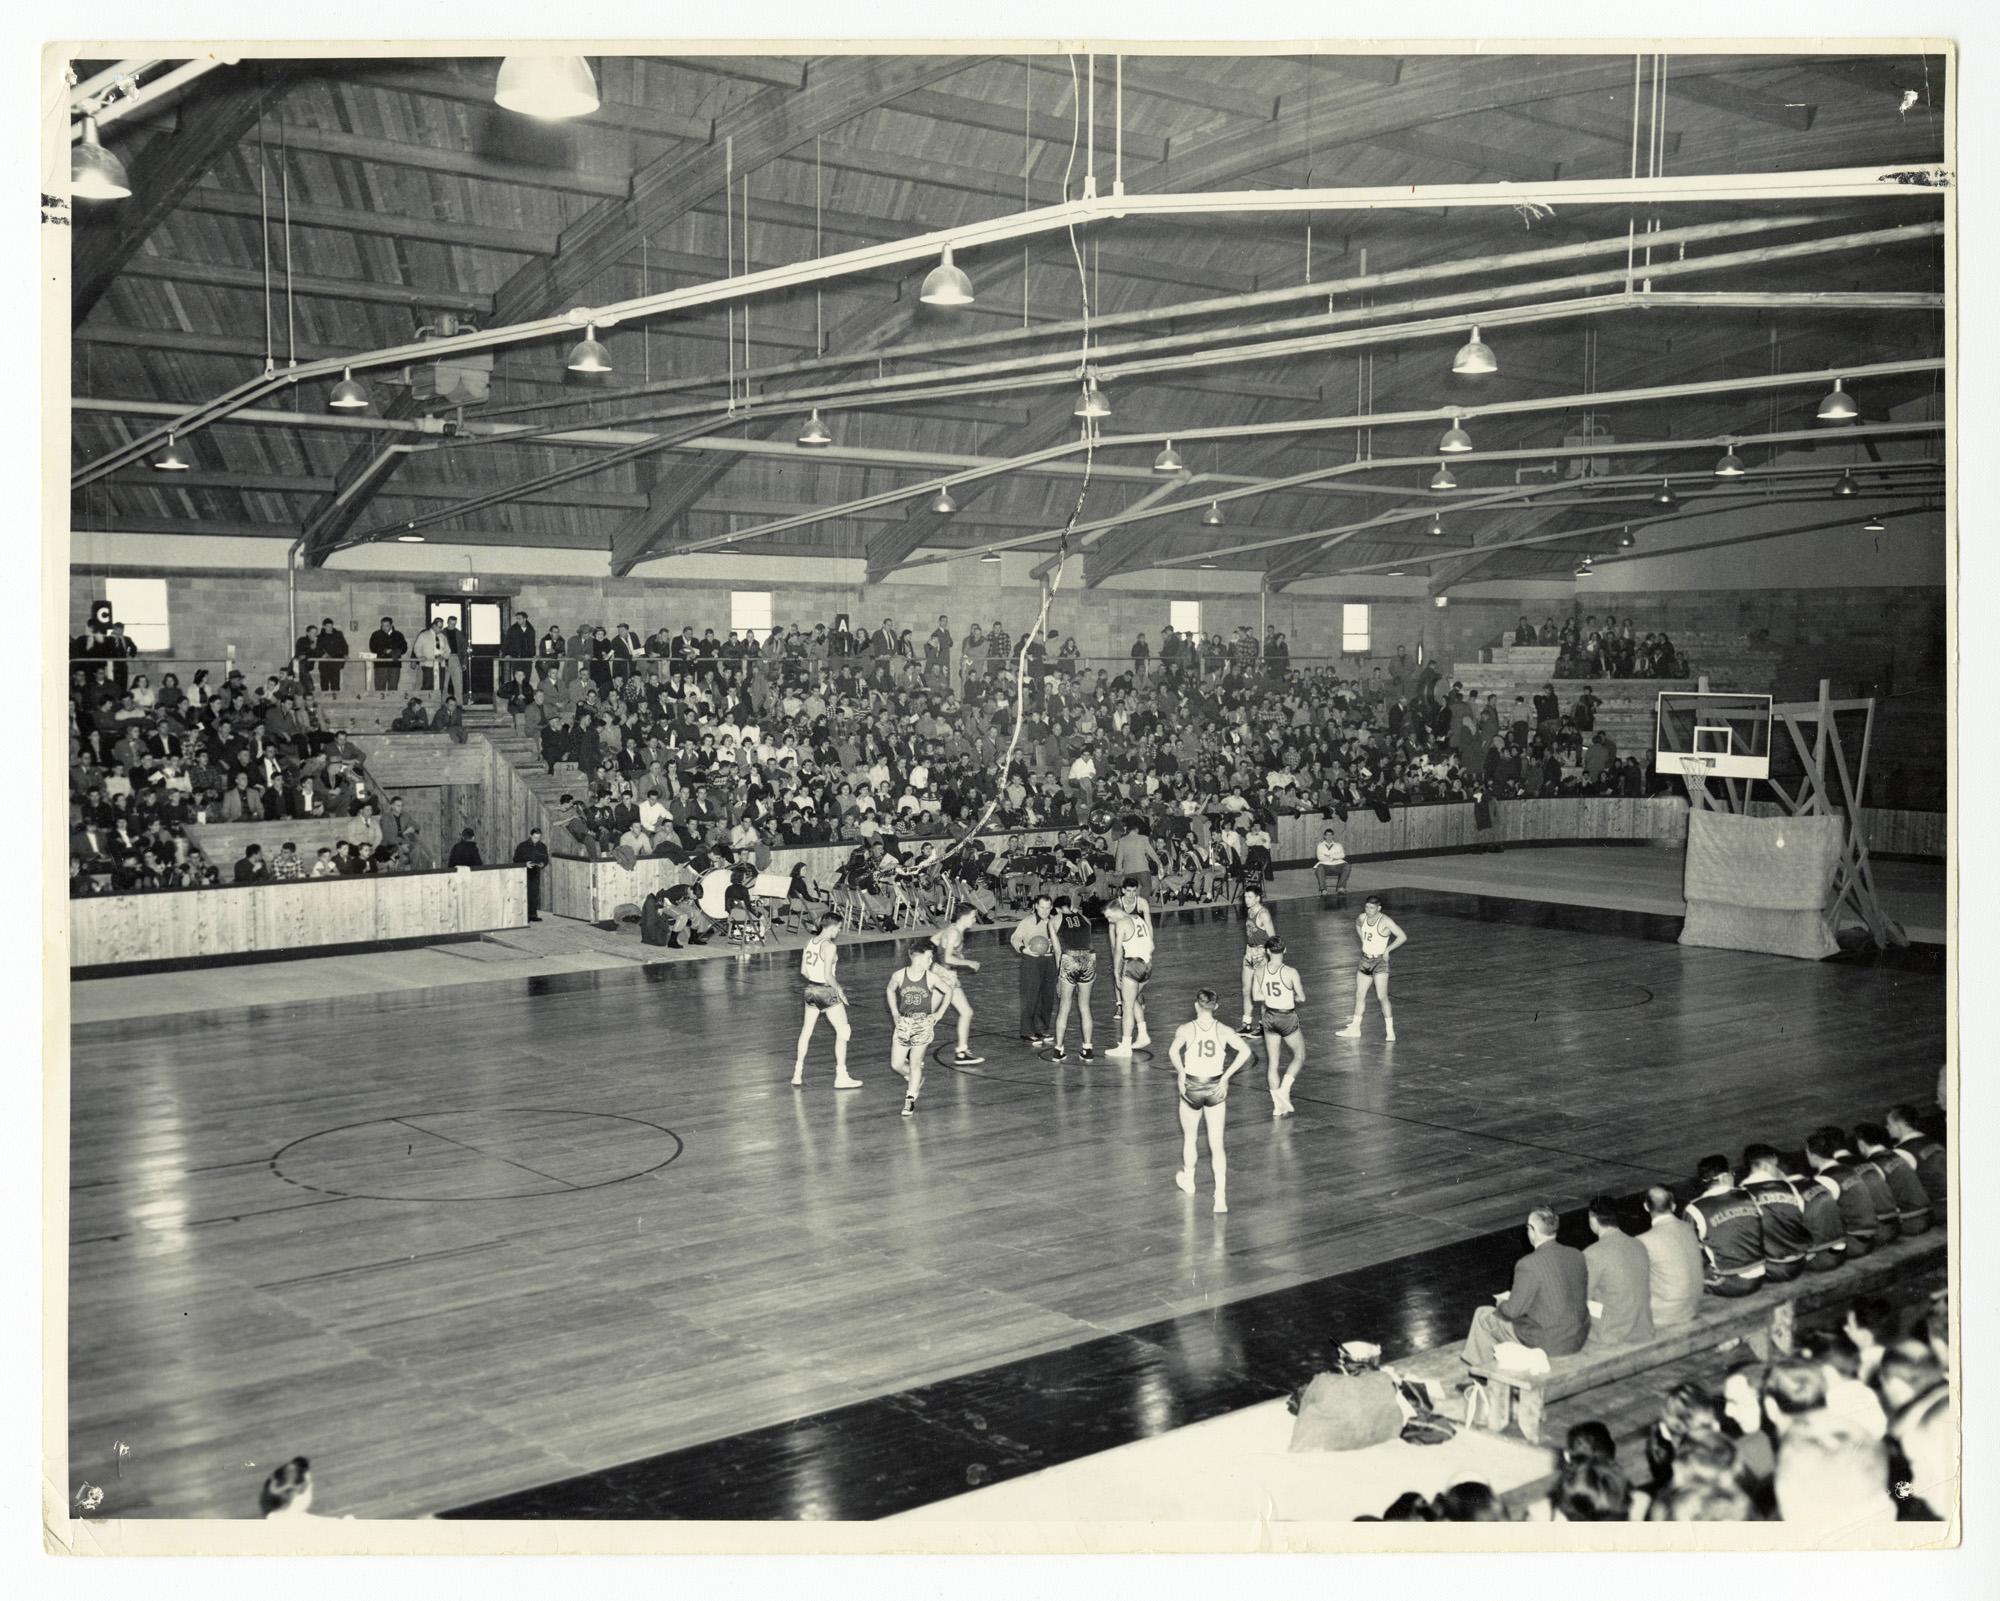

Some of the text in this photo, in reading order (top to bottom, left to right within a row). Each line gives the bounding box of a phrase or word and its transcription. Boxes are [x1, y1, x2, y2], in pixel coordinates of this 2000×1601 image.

[97, 607, 110, 623] C
[839, 619, 848, 632] A
[1136, 924, 1148, 937] 21
[1364, 931, 1373, 942] 12
[805, 950, 818, 966] 27
[1266, 981, 1281, 996] 15
[1197, 1039, 1216, 1057] 19
